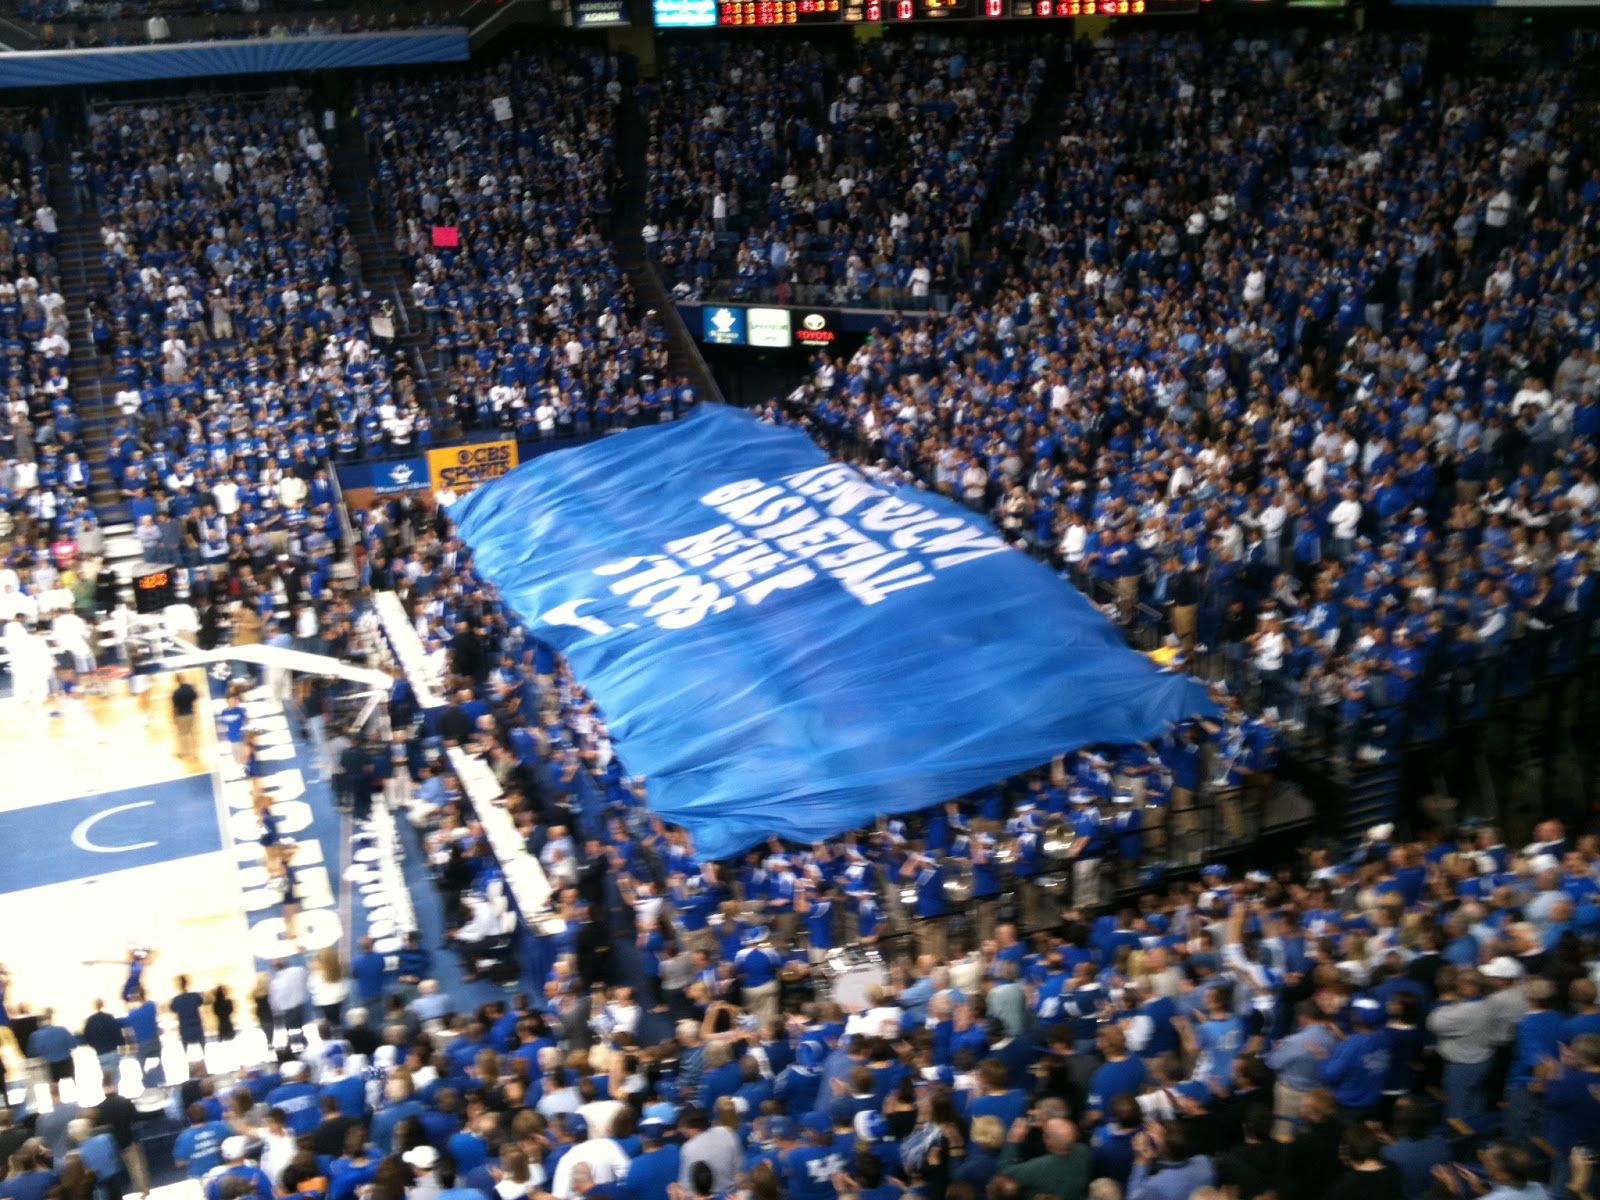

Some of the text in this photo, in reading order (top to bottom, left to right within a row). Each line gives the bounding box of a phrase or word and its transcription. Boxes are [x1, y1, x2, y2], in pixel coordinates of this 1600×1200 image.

[578, 1, 623, 12] KENTUCKY
[583, 11, 620, 22] KORNER
[797, 330, 835, 341] TOYOTA
[474, 445, 511, 463] CBS
[440, 461, 511, 487] SPORTS
[778, 462, 1012, 571] KENTUCKY
[700, 478, 937, 606] BASKETBALL
[663, 523, 818, 606] NEVER
